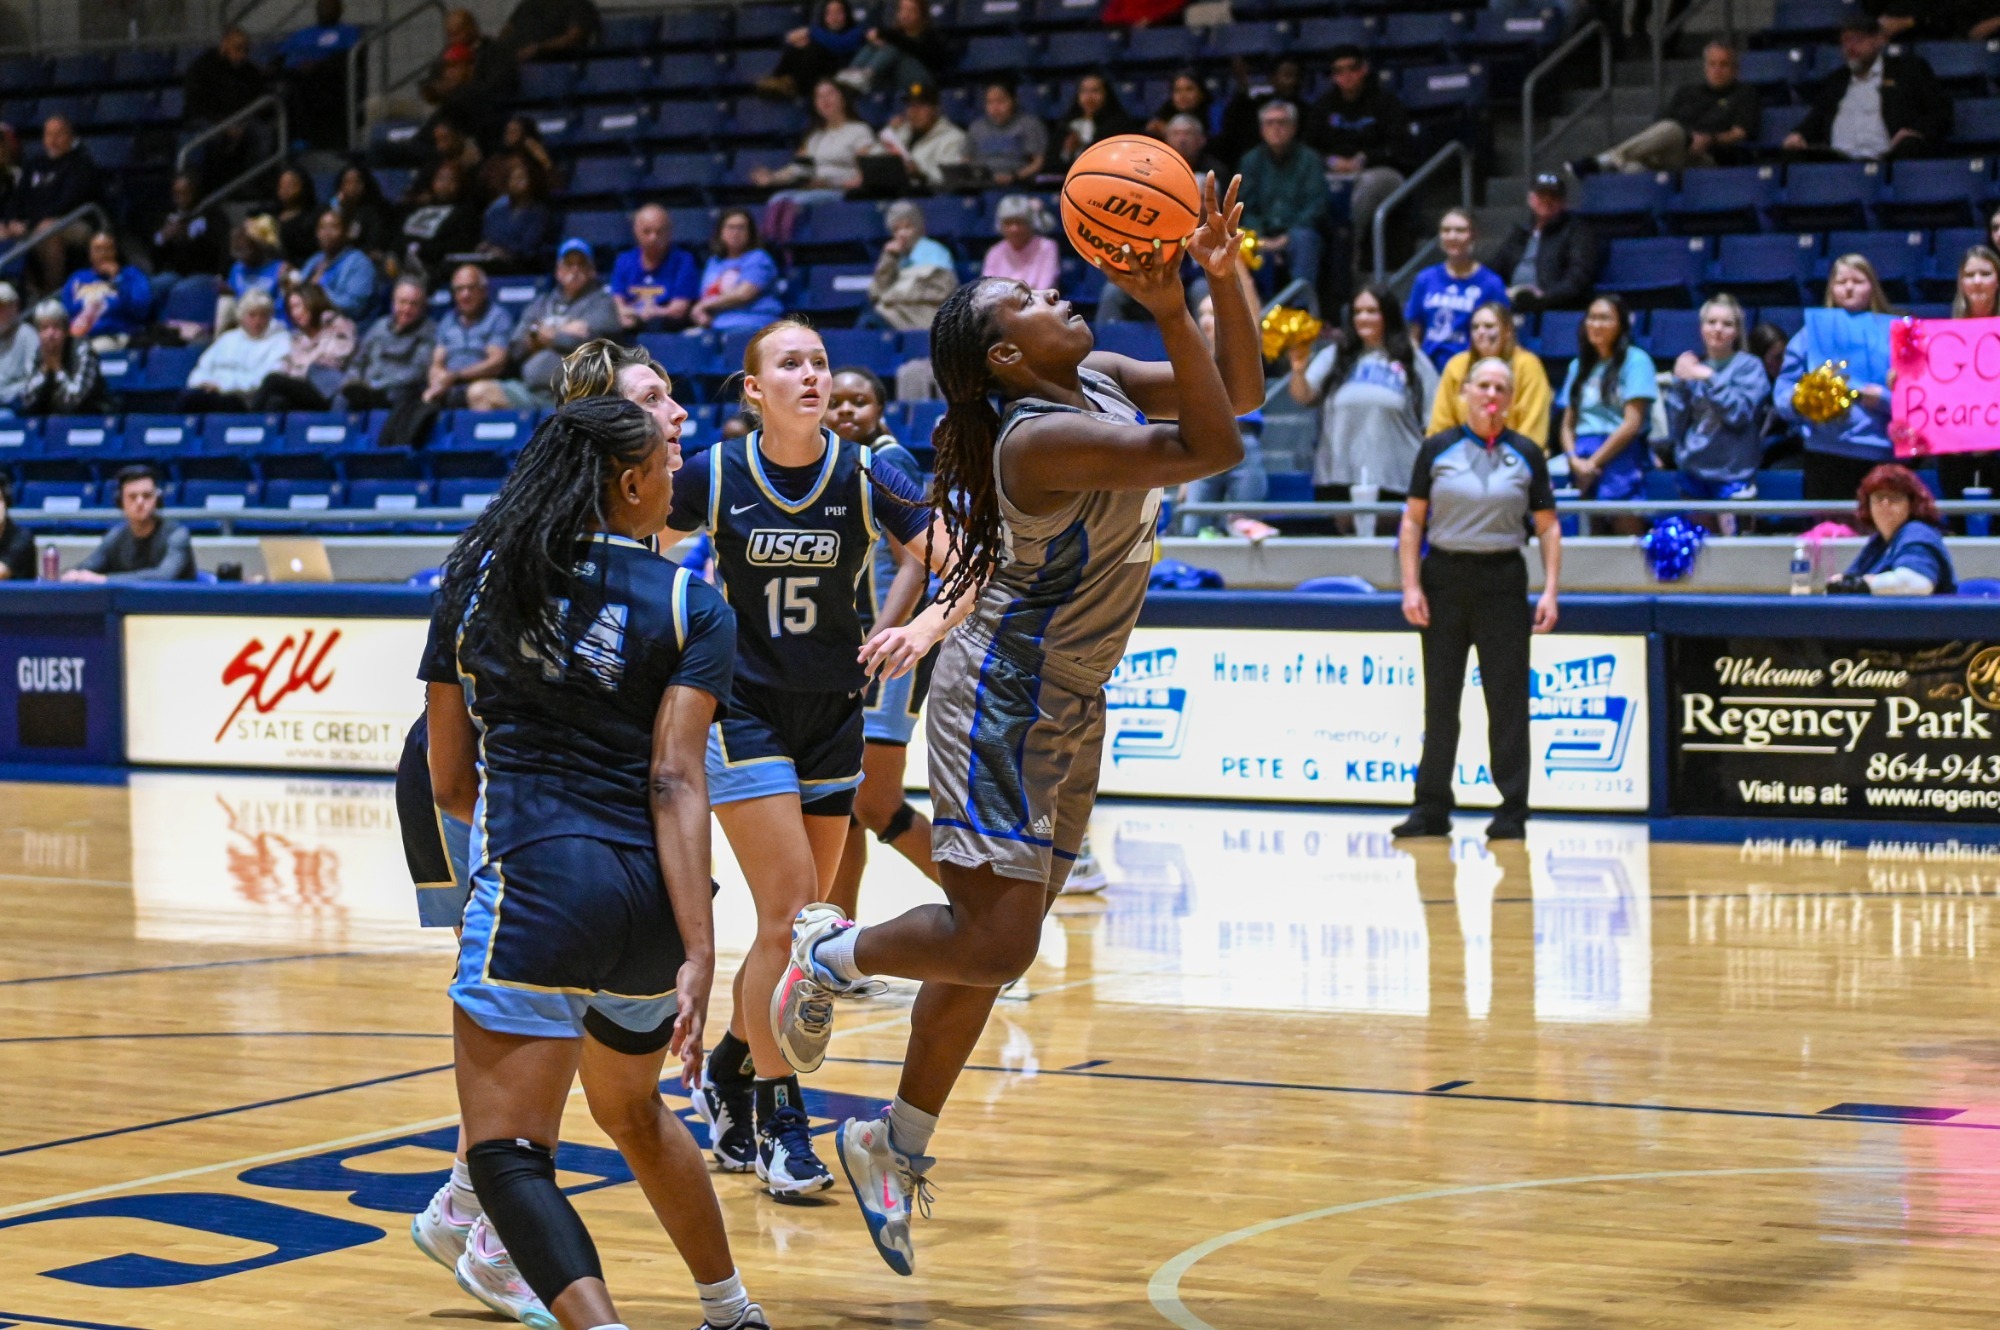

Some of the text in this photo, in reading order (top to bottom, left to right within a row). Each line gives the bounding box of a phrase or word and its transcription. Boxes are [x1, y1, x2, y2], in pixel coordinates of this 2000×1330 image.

[1103, 196, 1160, 226] EVO
[1926, 330, 2000, 383] GO
[750, 533, 837, 564] USCB
[764, 576, 820, 638] 15
[18, 656, 85, 692] GUEST
[1214, 652, 1416, 686] Home of the Dixie
[1713, 656, 1909, 688] Welcome Home
[237, 719, 304, 742] STATE
[312, 721, 392, 744] CREDIT
[1681, 692, 1993, 752] Regency Park
[1222, 757, 1285, 779] PETE
[1865, 752, 2000, 784] 864-943
[1737, 780, 1786, 804] Visit
[1789, 784, 1816, 804] us
[1820, 783, 1849, 805] at:
